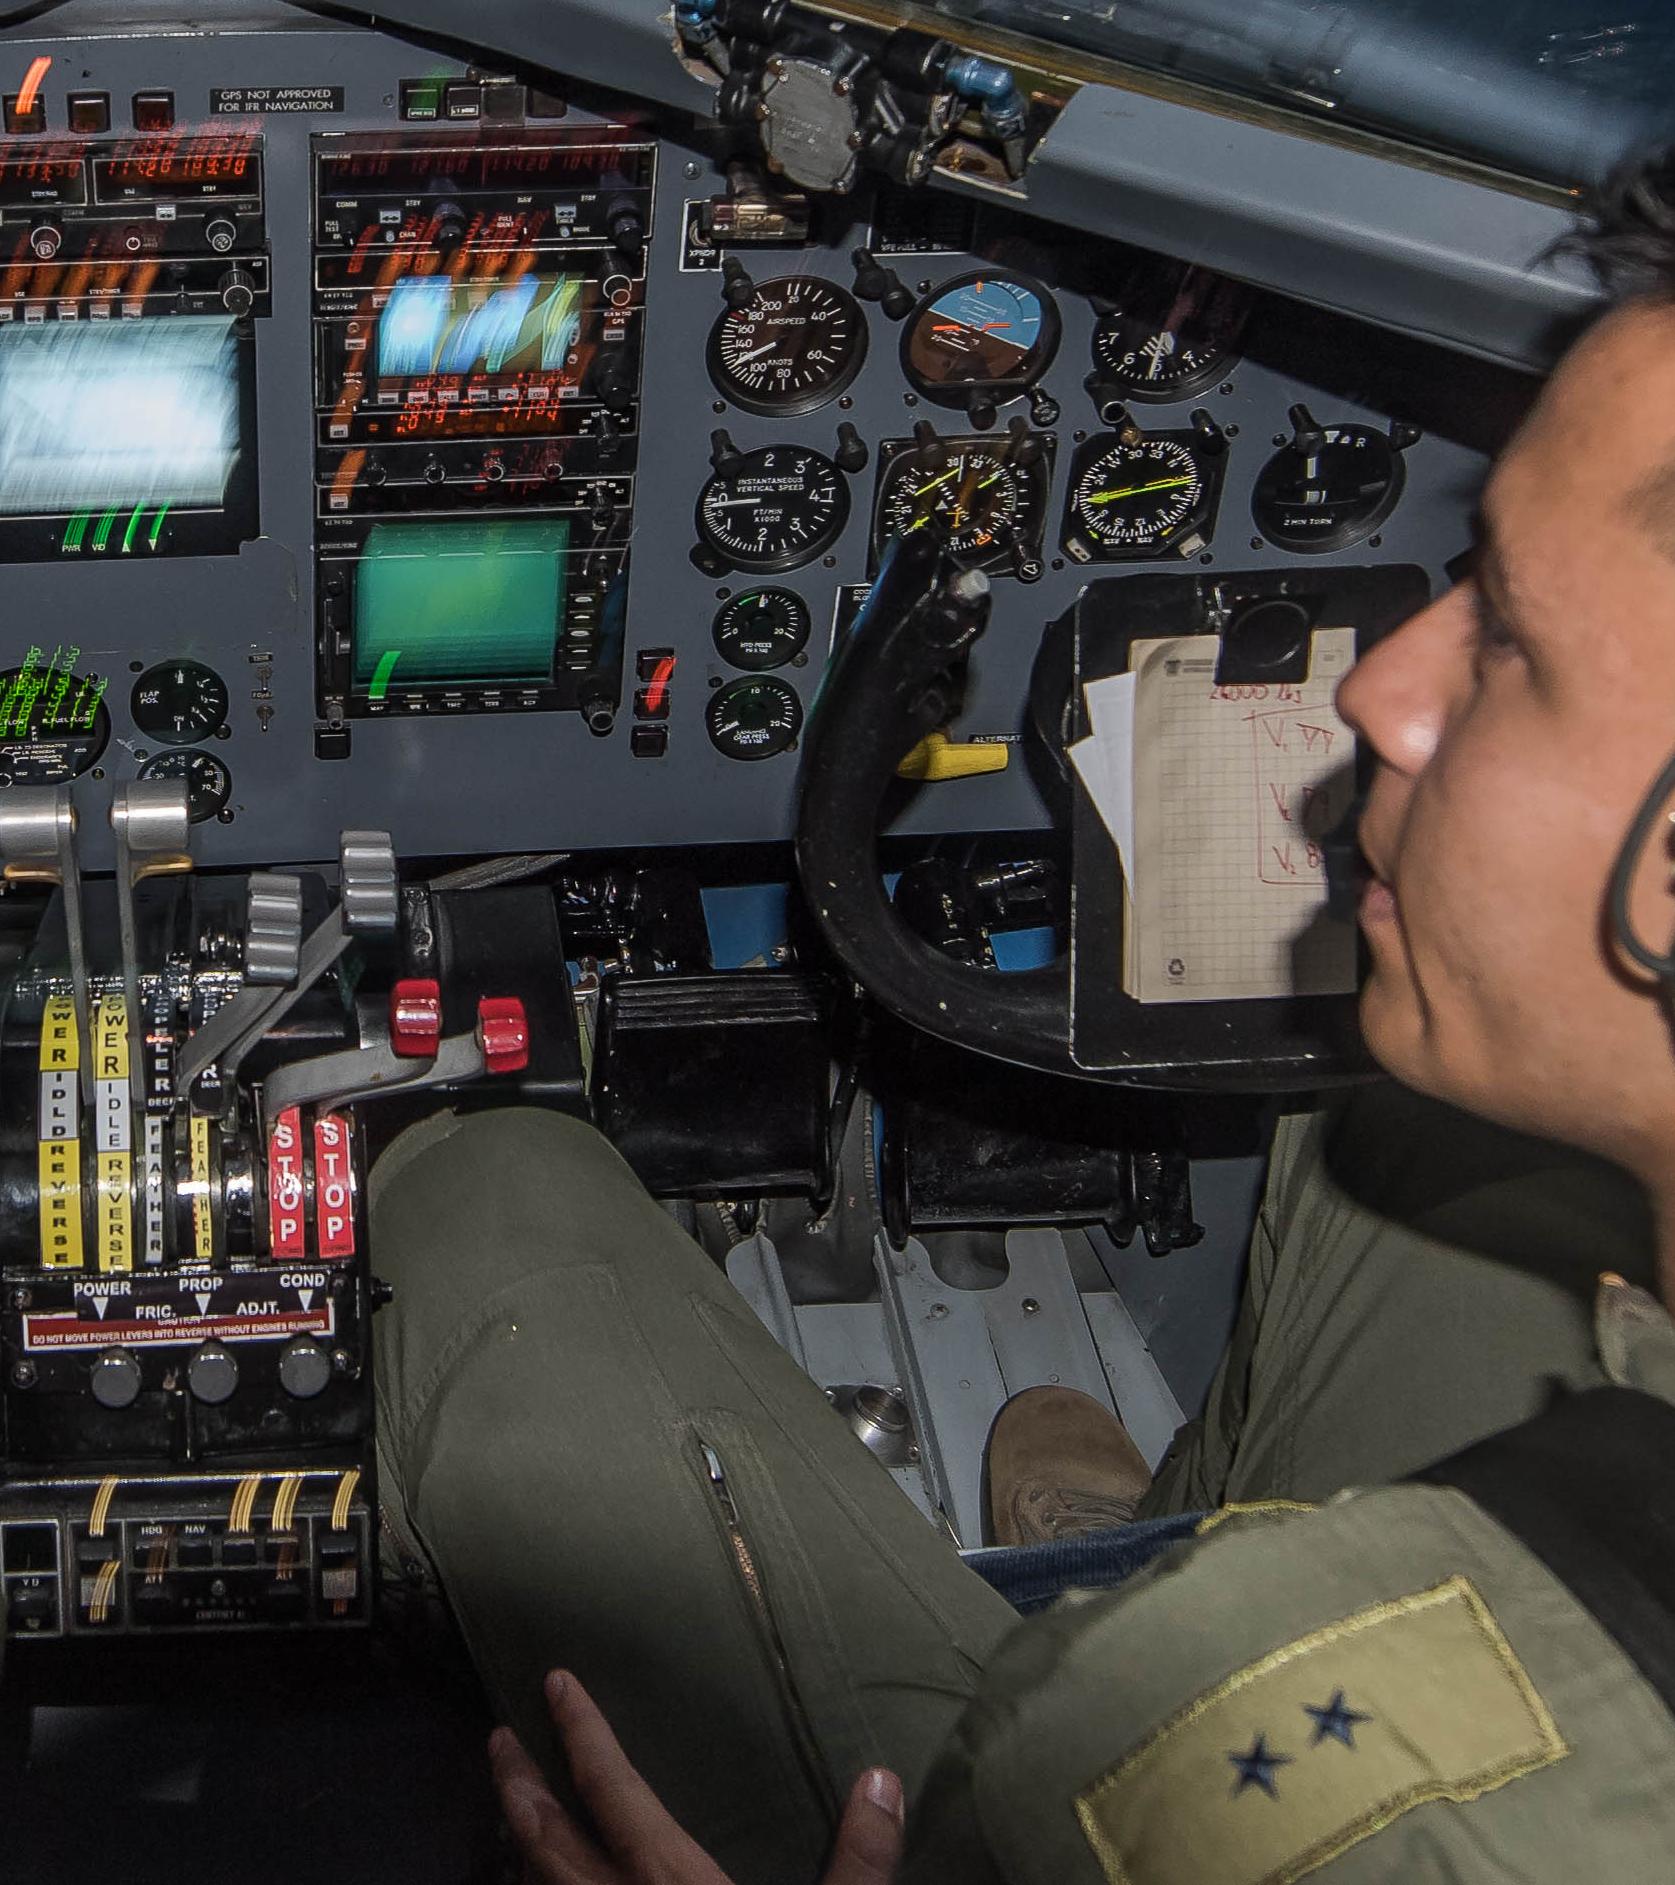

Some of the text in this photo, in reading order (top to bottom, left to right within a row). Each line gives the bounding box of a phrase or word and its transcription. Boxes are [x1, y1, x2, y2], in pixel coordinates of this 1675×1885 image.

[221, 89, 331, 100] GPS NOT APPROVED
[218, 101, 334, 112] FOR IFR NAVIGATION
[788, 295, 799, 304] 20
[761, 300, 781, 311] 200
[748, 310, 764, 321] 180
[766, 317, 806, 325] AIRSPEED
[810, 311, 826, 321] 40
[738, 324, 754, 334] 160
[735, 338, 753, 348] 140
[1108, 332, 1119, 345] 7
[806, 349, 822, 360] 60
[1123, 352, 1135, 365] 6
[1182, 350, 1194, 363] 4
[750, 362, 767, 373] 100
[767, 358, 793, 366] KNOTS
[776, 368, 791, 379] 80
[1128, 449, 1163, 459] 30 33
[764, 453, 775, 467] 2
[737, 477, 804, 486] INSTANTANEOUS
[736, 483, 804, 493] VERTICAL SPEED
[808, 489, 820, 502] 4
[139, 690, 160, 699] FLAP
[973, 734, 1024, 744] ALTERNAT
[106, 1082, 122, 1149] IDLE
[276, 1124, 298, 1243] STOP
[323, 1120, 345, 1242] STOP
[196, 1123, 211, 1252] FEAHER
[51, 1144, 69, 1264] REVERSE
[107, 1158, 125, 1267] REVERSE
[74, 1273, 325, 1297] POWER PROP COND
[135, 1301, 280, 1320] FRIC. ADJT.
[46, 1335, 63, 1344] NOT
[65, 1334, 88, 1343] MOVE
[90, 1332, 120, 1343] POWER
[121, 1330, 153, 1342] LEVERS
[175, 1327, 212, 1339] REVERSE
[214, 1324, 250, 1337] WITHOUT
[185, 1524, 206, 1534] NAV
